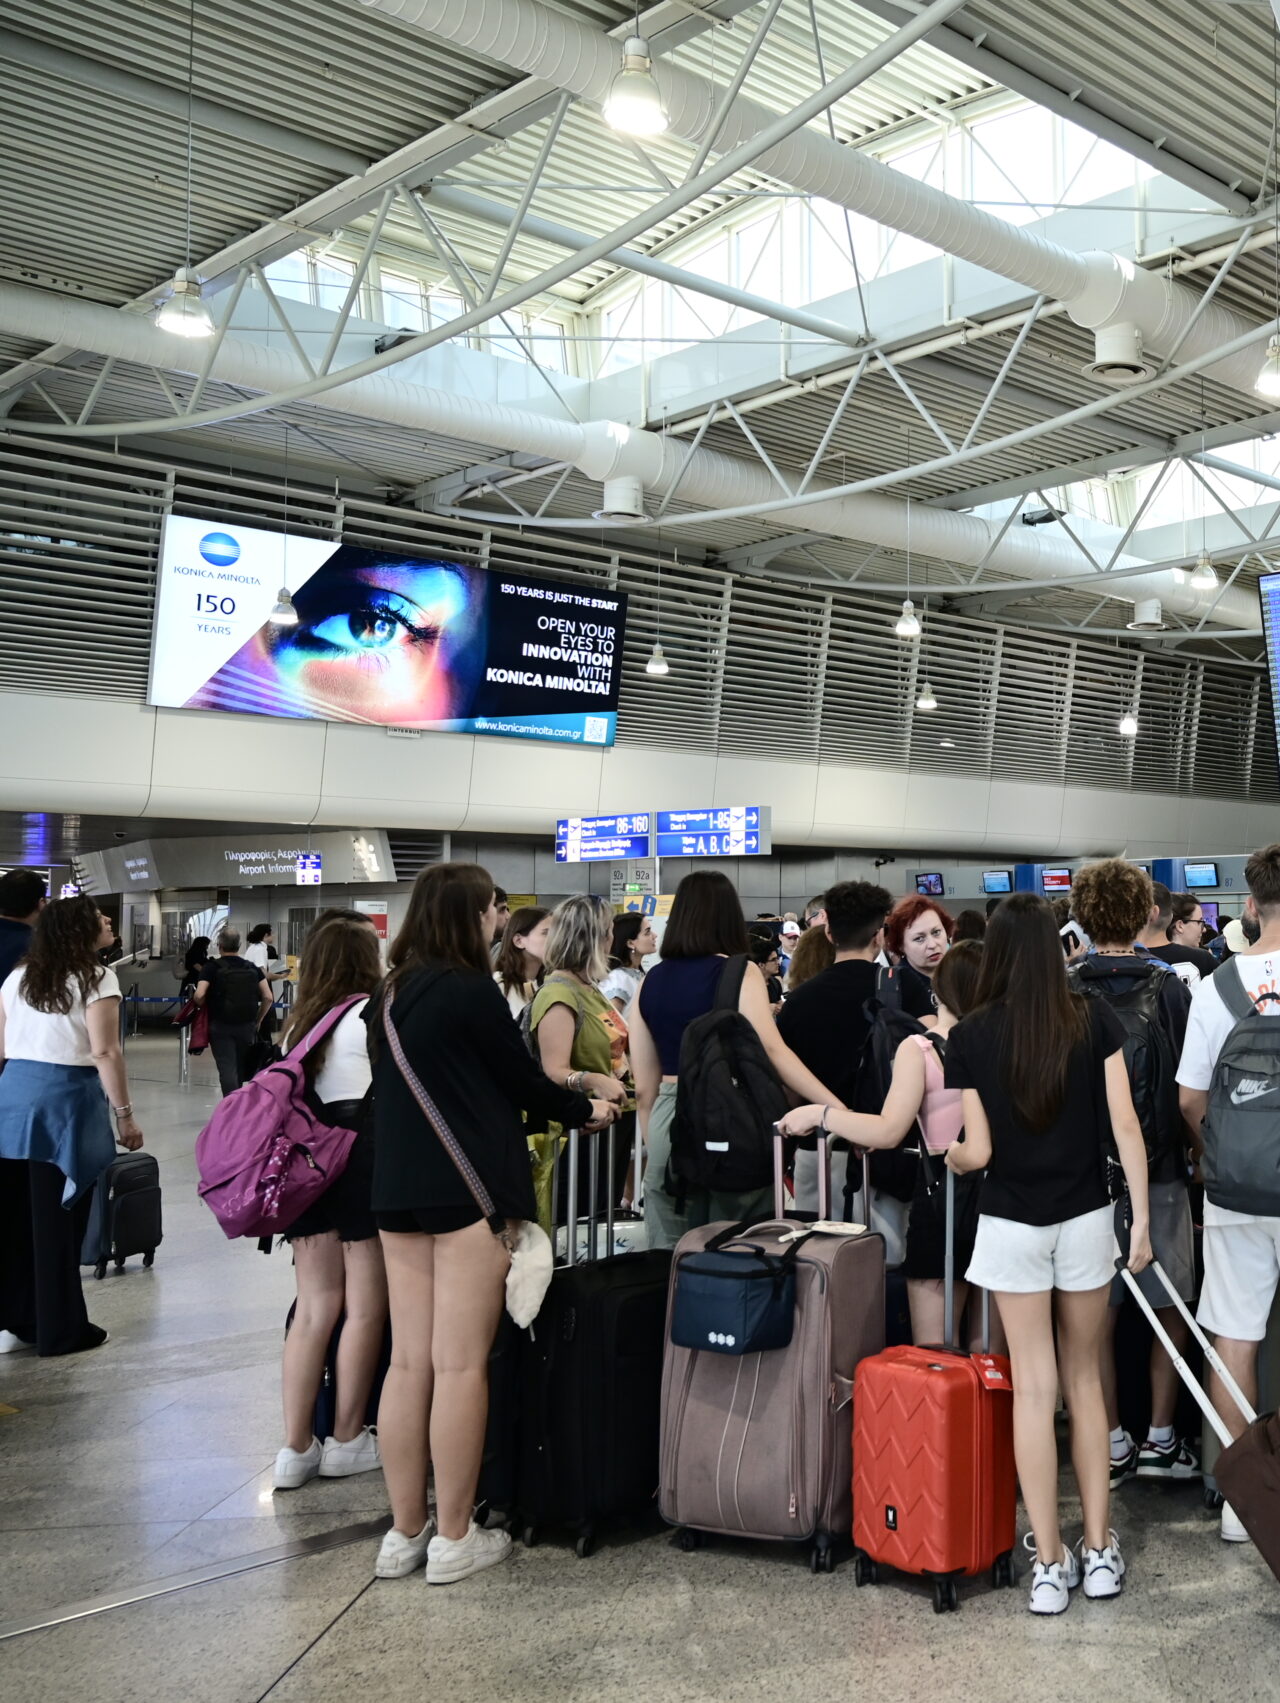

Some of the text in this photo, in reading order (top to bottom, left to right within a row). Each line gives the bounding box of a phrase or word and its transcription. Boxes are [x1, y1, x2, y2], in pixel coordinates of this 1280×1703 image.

[174, 566, 261, 586] KONICA MINOLTA
[196, 594, 236, 615] 150
[501, 584, 619, 611] 150 YEARS IS JUST THE START
[197, 624, 231, 636] YEARS
[537, 616, 615, 639] OPEN YOUR
[561, 634, 614, 653] EYES TO
[522, 643, 613, 667] INNOVATION
[486, 668, 610, 695] KONICA MINOLTA!
[577, 665, 611, 681] WITH
[475, 721, 582, 739] www.konicaminolta.com.gr
[617, 816, 648, 834] 86-160
[709, 811, 730, 829] 1-85
[723, 835, 730, 852] C
[239, 865, 266, 876] Airport
[636, 871, 650, 880] 92a
[1225, 878, 1233, 887] 87
[1237, 1079, 1268, 1091] NIKE
